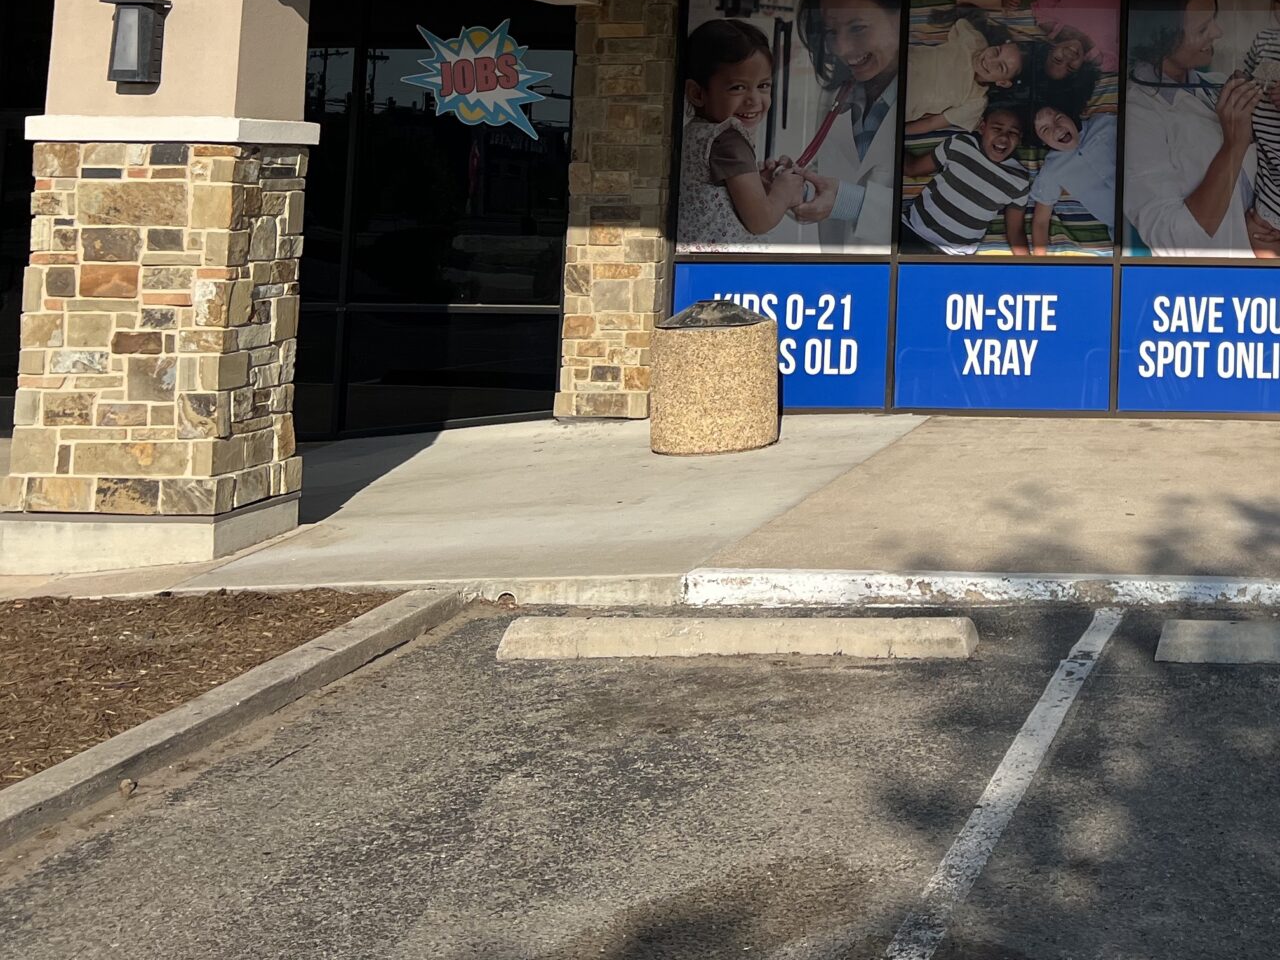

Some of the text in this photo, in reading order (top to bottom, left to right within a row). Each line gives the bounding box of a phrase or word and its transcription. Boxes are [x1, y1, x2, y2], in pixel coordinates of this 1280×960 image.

[440, 53, 519, 97] JOBS
[785, 293, 852, 331] 0-21
[945, 293, 1058, 332] ON-SITE
[1152, 296, 1225, 333] SAVE
[804, 338, 858, 375] OLD
[962, 338, 1039, 376] XRAY
[1138, 340, 1210, 378] SPOT
